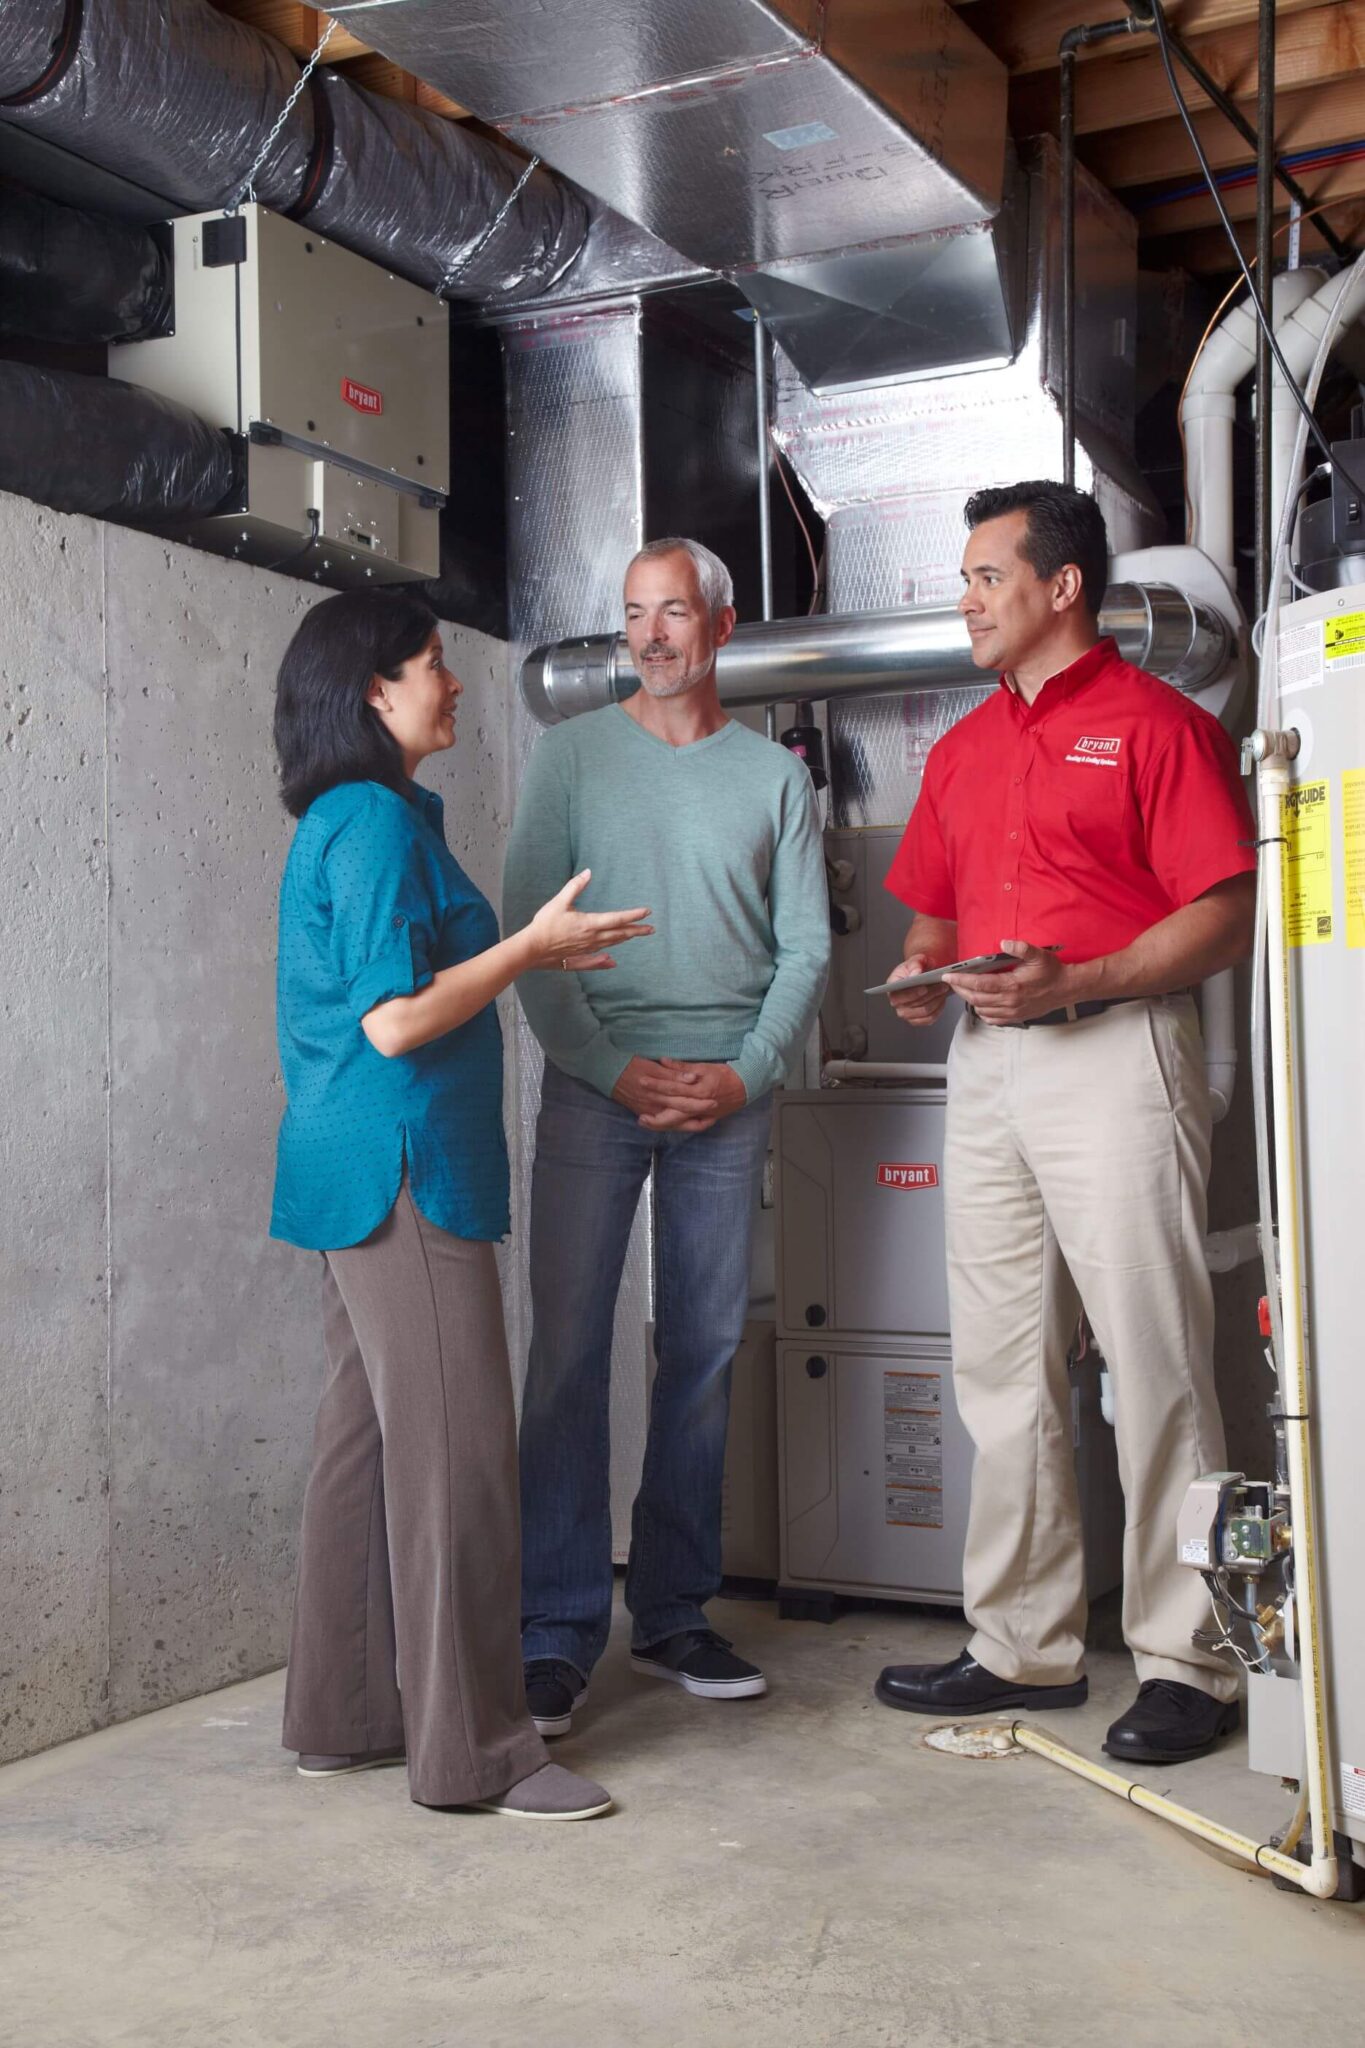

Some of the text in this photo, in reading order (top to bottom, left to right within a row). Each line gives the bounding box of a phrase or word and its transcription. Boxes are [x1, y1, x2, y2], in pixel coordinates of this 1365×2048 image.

[348, 384, 378, 409] bryant
[1081, 738, 1115, 751] bryant
[884, 1168, 930, 1184] bryant
